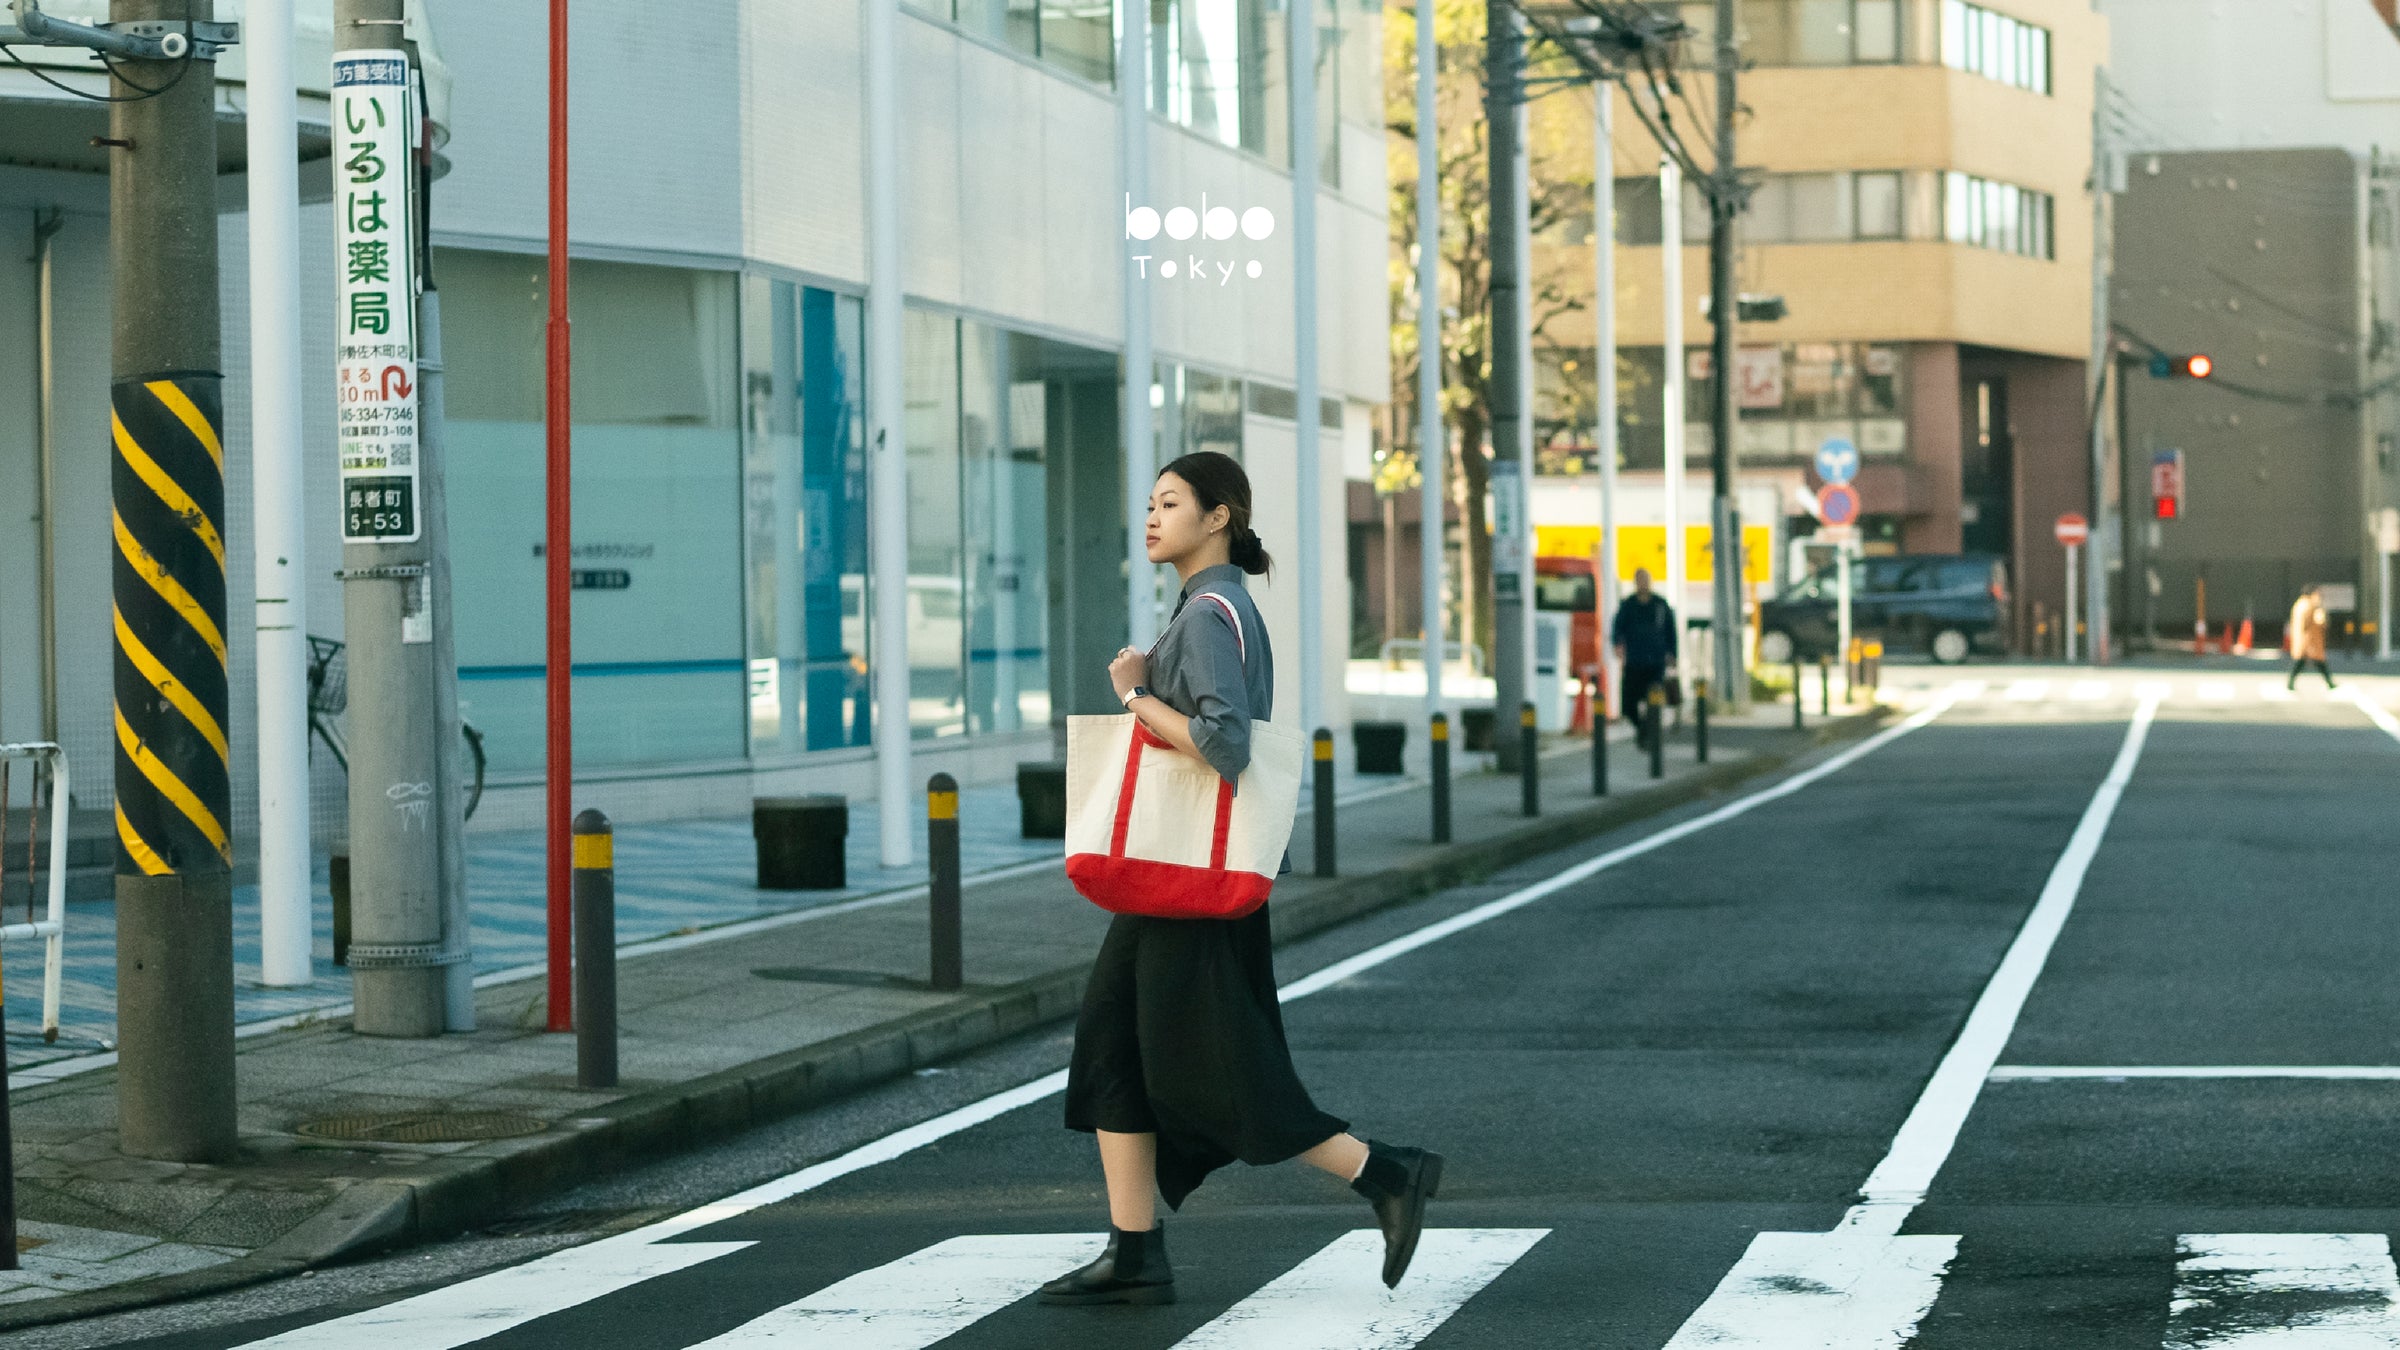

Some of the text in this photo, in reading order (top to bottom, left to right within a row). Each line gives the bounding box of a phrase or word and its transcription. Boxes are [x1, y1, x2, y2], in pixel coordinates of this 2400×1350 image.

[345, 97, 391, 336] いるは薬局
[350, 489, 402, 509] 長者町
[351, 512, 402, 531] 5-53
